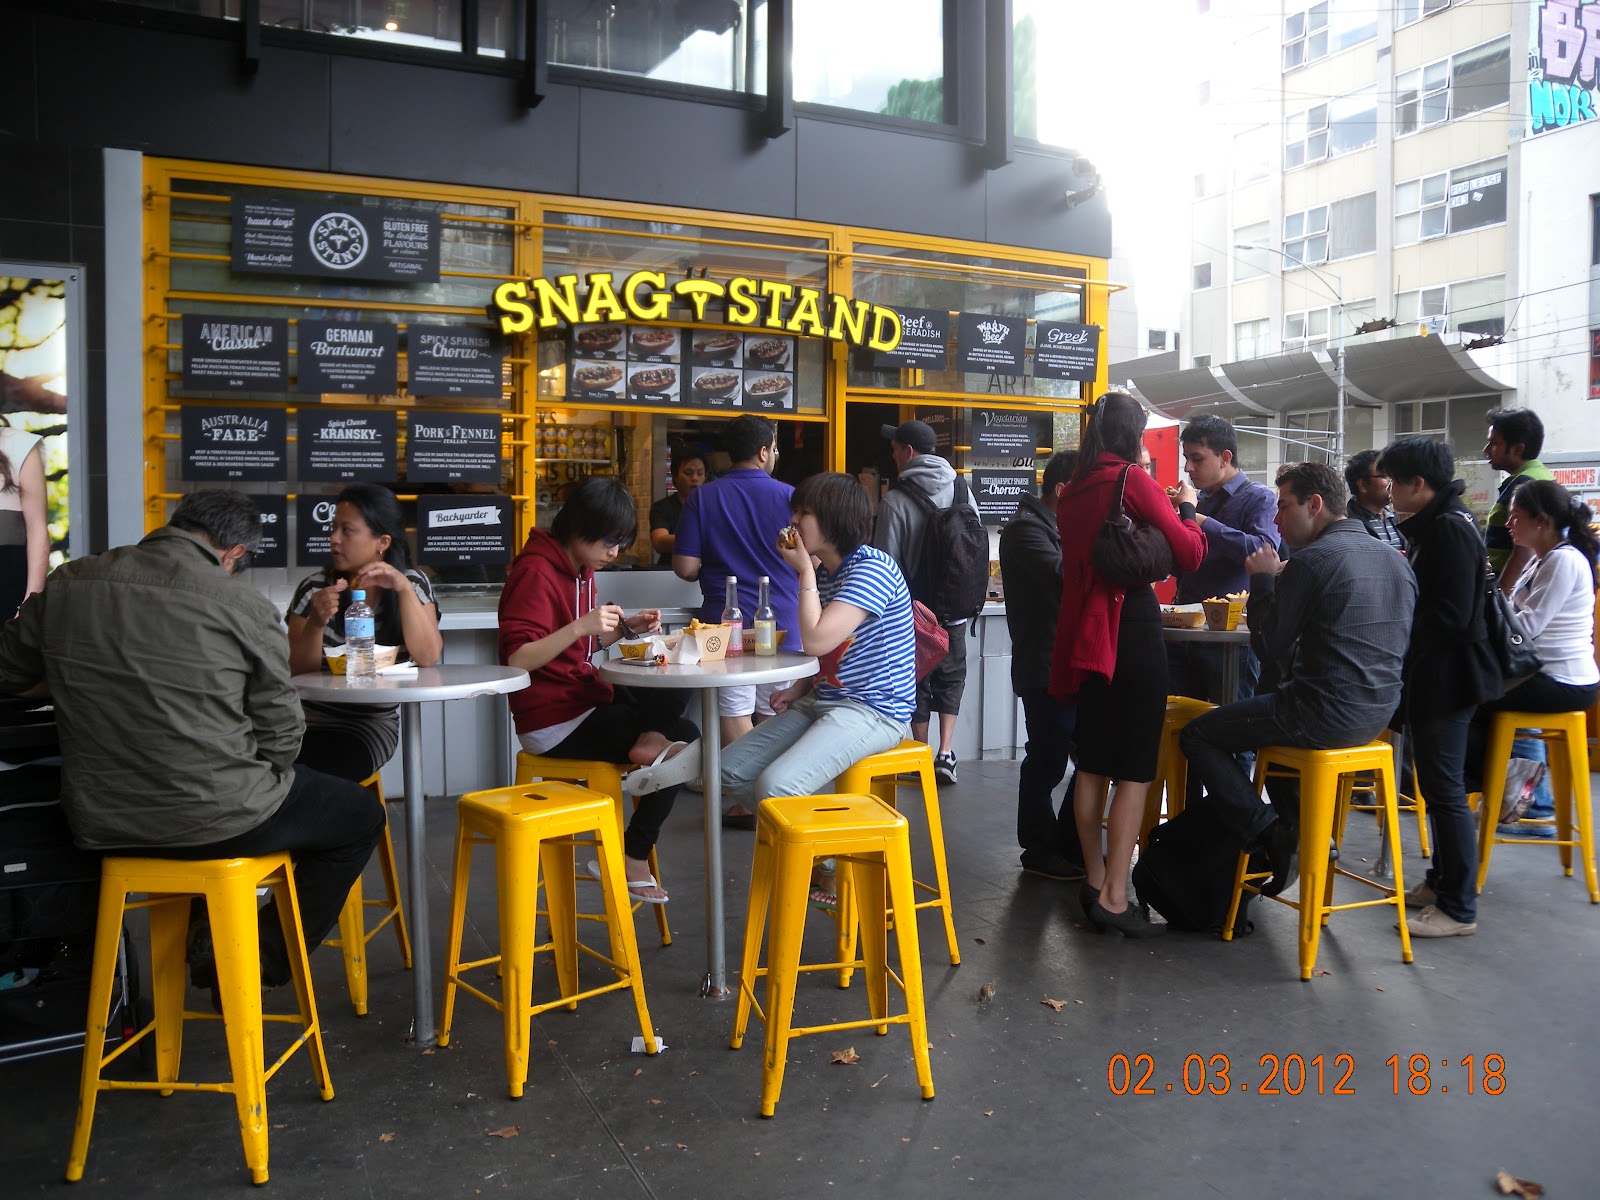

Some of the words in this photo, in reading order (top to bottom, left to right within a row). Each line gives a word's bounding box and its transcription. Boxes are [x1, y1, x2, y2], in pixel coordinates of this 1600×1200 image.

[1451, 184, 1469, 195] FOR
[1471, 174, 1501, 189] LEASE
[318, 218, 360, 238] SNAG
[384, 221, 410, 231] GLUTEN
[411, 223, 428, 233] FREE
[396, 232, 428, 241] Artificial
[384, 240, 429, 249] FLAVOURS
[316, 241, 361, 263] STAND
[388, 262, 423, 270] ARTISANAL
[492, 270, 673, 336] SNAG
[727, 275, 903, 354] STAND
[200, 323, 272, 342] AMERICAN
[902, 328, 941, 338] SERADISH
[977, 320, 1010, 335] Wagyu
[326, 328, 373, 343] GERMAN
[420, 334, 448, 345] SPICY
[450, 336, 490, 347] SPANISH
[982, 330, 1005, 344] Beef
[1048, 328, 1088, 344] Greek
[211, 337, 260, 350] Classic
[310, 341, 385, 357] Bratwurst
[432, 343, 478, 358] Chorizo
[201, 414, 268, 432] AUSTRALIA
[328, 420, 345, 429] Spicy
[346, 419, 367, 427] Cheese
[981, 412, 1027, 426] Vegetarian
[212, 428, 258, 442] FARE
[320, 428, 376, 440] KRANSKY
[414, 424, 444, 439] PORK
[452, 425, 496, 440] FENNEL
[1554, 469, 1595, 484] DUNCAN'S
[989, 483, 1020, 495] Chorizo
[436, 511, 488, 523] Backyarder
